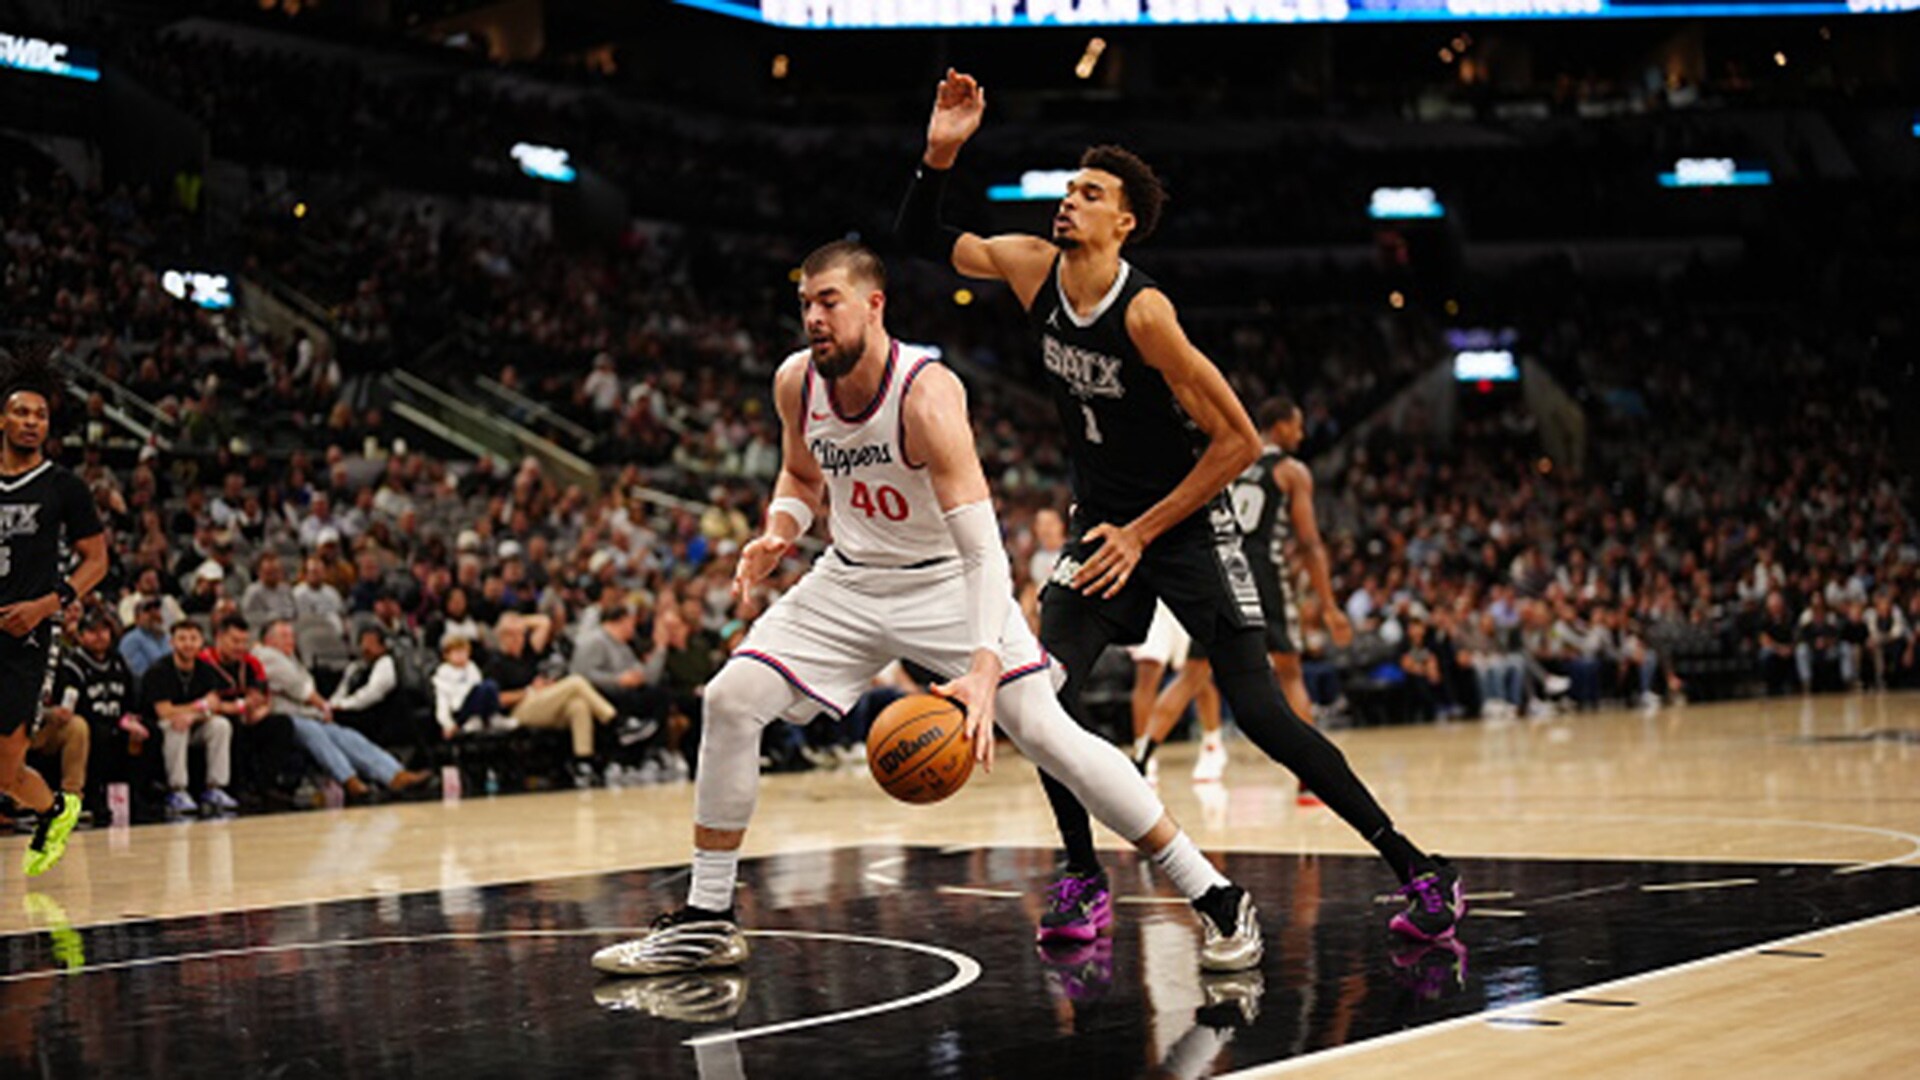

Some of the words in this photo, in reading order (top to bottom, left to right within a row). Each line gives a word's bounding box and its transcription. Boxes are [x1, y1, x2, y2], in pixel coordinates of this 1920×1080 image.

[1081, 404, 1103, 444] 1
[811, 438, 893, 477] Clippers
[850, 481, 910, 522] 40
